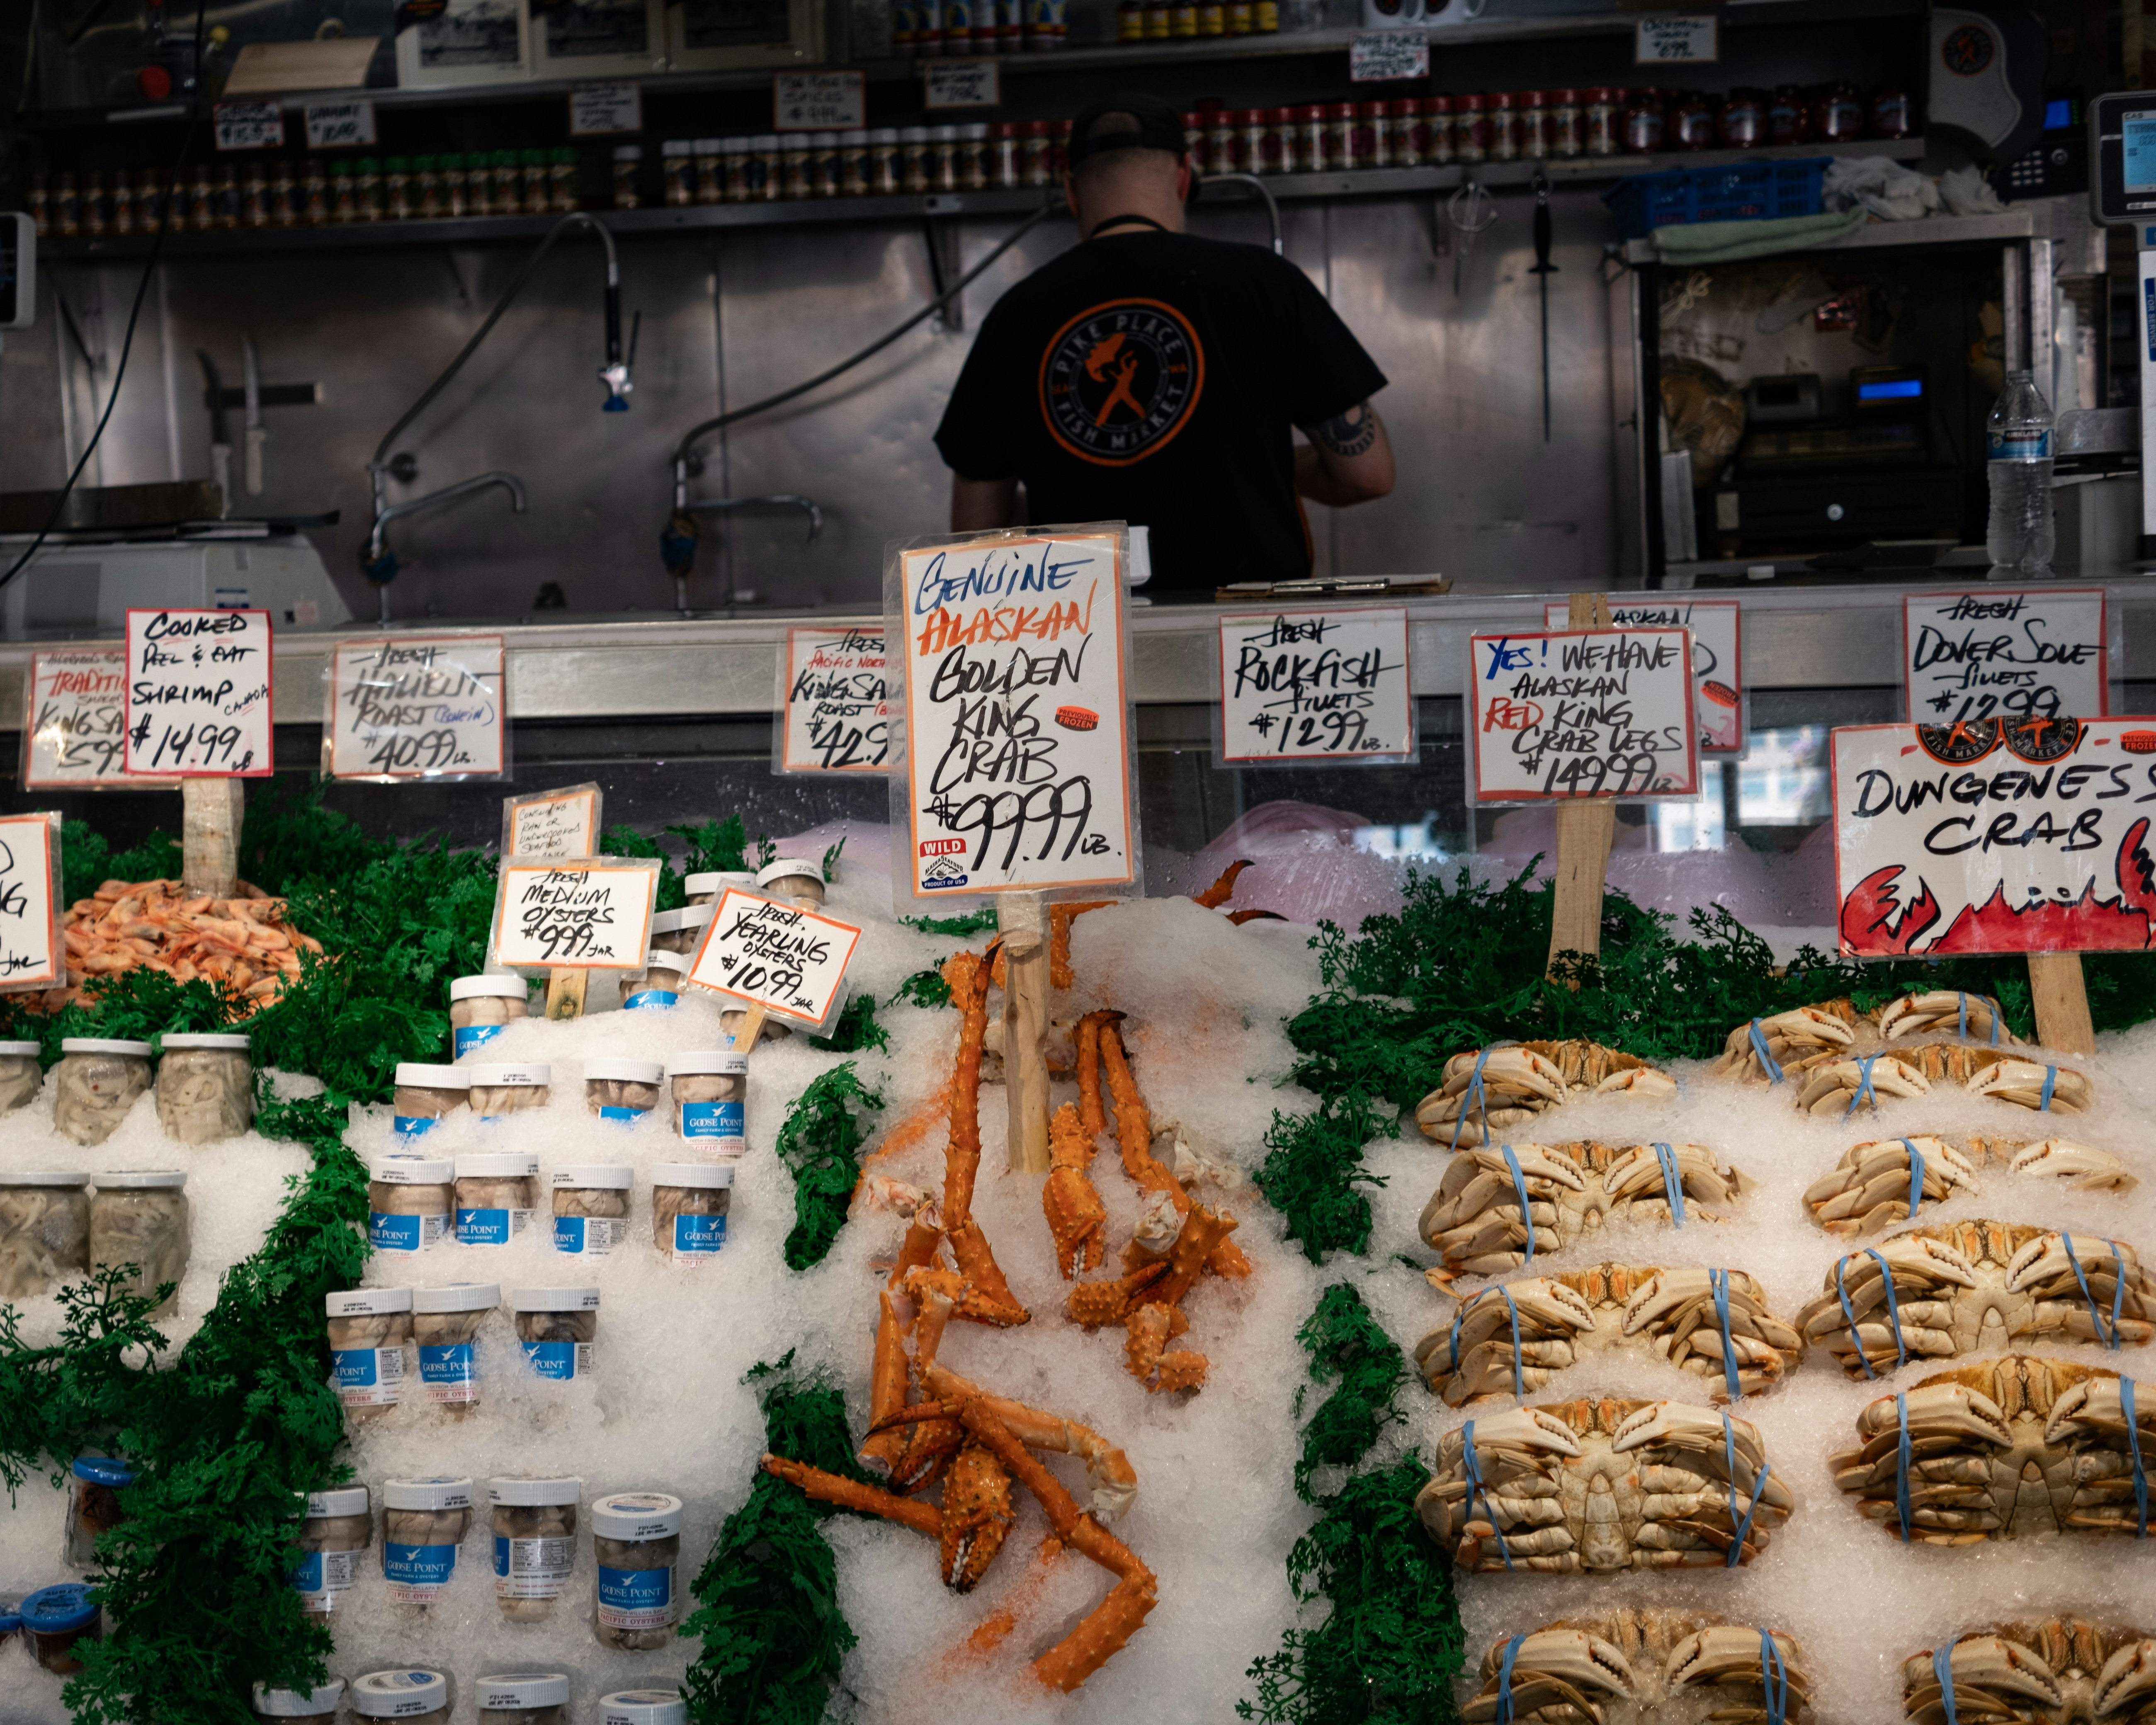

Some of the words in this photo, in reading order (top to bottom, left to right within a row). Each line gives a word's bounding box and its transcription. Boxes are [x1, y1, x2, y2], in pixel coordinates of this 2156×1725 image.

[2147, 294, 2155, 311] FOR
[1056, 323, 1102, 373] PIKE
[1115, 314, 1182, 355] PLACE
[1056, 401, 1100, 444] FISH
[1110, 384, 1183, 449] MARKET
[914, 543, 1095, 615] GENUINE
[917, 578, 1097, 656] ALASKAN
[1937, 594, 2029, 620] FRESH
[144, 612, 247, 641] COOKED
[1243, 615, 1341, 647] FRESH
[142, 642, 184, 674] PEEL
[211, 646, 259, 663] EAT
[350, 641, 447, 668] FRESH
[1913, 625, 2013, 672] DOVER
[2008, 618, 2107, 664] SOLE
[807, 649, 853, 670] PACIFIC
[929, 633, 1093, 703] GOLDEN
[1234, 646, 1404, 698] ROCKFISH
[342, 668, 504, 705] HALIBUT
[789, 669, 850, 702] KING
[1510, 670, 1630, 699] ALASKAN
[1933, 661, 2038, 690] FILLETS
[132, 680, 233, 707] SHRIMP
[1263, 685, 1374, 714] FILLETS
[351, 702, 448, 733] ROAST
[812, 701, 876, 719] ROAST
[952, 694, 1040, 746] KING
[1059, 709, 1097, 721] PREVIOUSLY
[1059, 716, 1093, 729] FROZEN
[1483, 697, 1544, 733] RED
[1553, 698, 1633, 732] KING
[129, 713, 242, 768] $14.99
[1249, 710, 1369, 753] $12.99
[1511, 724, 1599, 754] CRAB
[1610, 726, 1682, 752] LEGS
[1927, 736, 1949, 755] FISH
[1956, 728, 1993, 758] MARKET
[360, 729, 456, 774] $40.99
[2015, 738, 2063, 757] MARKET
[930, 737, 1058, 794] CRAB
[519, 822, 580, 844] UNDERCOOKED
[521, 821, 541, 835] RAW
[1924, 809, 2102, 855] CRAB
[924, 840, 961, 854] WILD
[531, 868, 588, 884] FRESH
[925, 858, 941, 875] ALASKA
[941, 855, 963, 871] SEAFOOD
[521, 885, 610, 905] MEDIUM
[523, 906, 614, 928] OYSTERS
[587, 944, 614, 958] JAR
[720, 911, 830, 965] YEARLING
[743, 941, 806, 972] OYSTERS
[790, 996, 814, 1013] JAR
[459, 1041, 482, 1050] GOOSE
[690, 1118, 718, 1127] GOOSE
[720, 1118, 742, 1127] POINT
[382, 1231, 410, 1240] POINT
[471, 1225, 499, 1234] POINT
[685, 1231, 713, 1241] GOOSE
[340, 1367, 365, 1376] POINT
[423, 1363, 447, 1372] GOOSE
[534, 1360, 564, 1369] POINT
[388, 1560, 411, 1572] GOOSE
[414, 1563, 446, 1572] POINT
[602, 1584, 627, 1597] GOOSE
[631, 1587, 662, 1597] POINT
[600, 1613, 626, 1624] PACIFIC
[631, 1616, 664, 1625] OYSTERS
